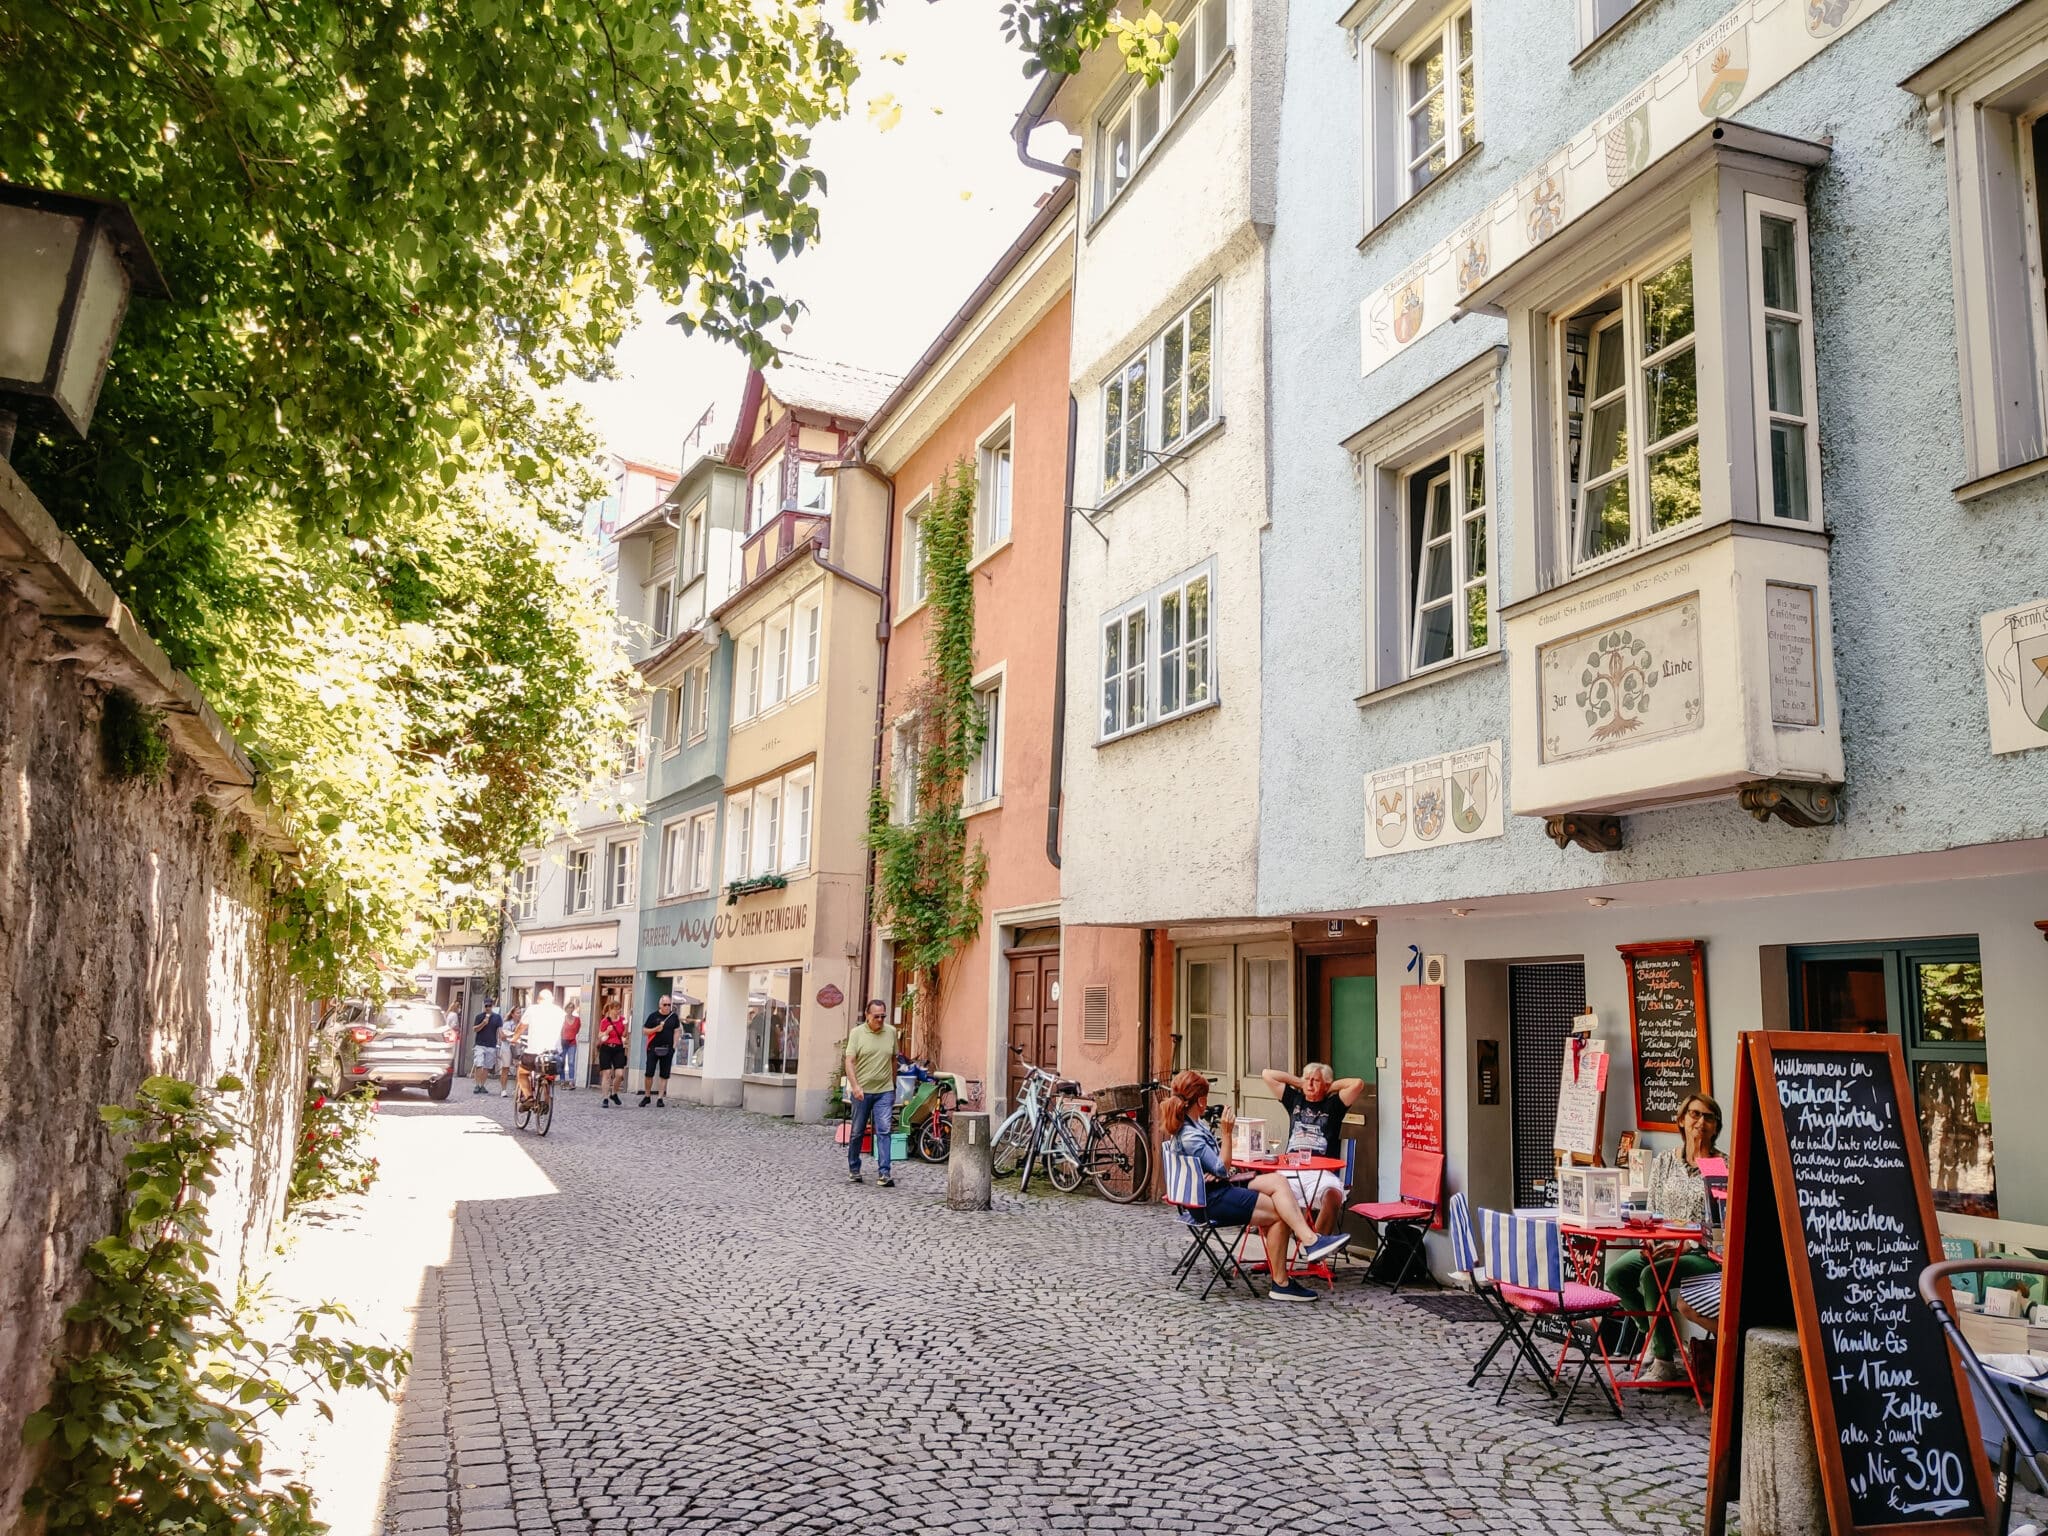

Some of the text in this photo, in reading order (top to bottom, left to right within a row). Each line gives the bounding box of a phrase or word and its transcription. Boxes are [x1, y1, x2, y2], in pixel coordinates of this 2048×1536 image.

[1661, 657, 1693, 679] Linde
[1552, 693, 1567, 712] Zur
[764, 903, 808, 934] REINIGUNG
[1773, 1058, 1847, 1077] Willkommen
[1790, 1135, 1805, 1150] der
[1793, 1152, 1841, 1167] anderen
[1872, 1156, 1905, 1168] seinen
[1798, 1188, 1846, 1208] Dinkel-
[1855, 1240, 1876, 1252] vom
[1887, 1257, 1912, 1275] mit
[1844, 1280, 1916, 1304] Bio-Sahne
[1821, 1305, 1843, 1324] oder
[1869, 1302, 1911, 1331] Kugel
[1832, 1328, 1908, 1354] Vanille-Eis
[1868, 1360, 1919, 1390] Tasse
[1882, 1392, 1943, 1435] Kaffee
[1841, 1423, 1868, 1445] alles
[1997, 1471, 2008, 1502] Joie
